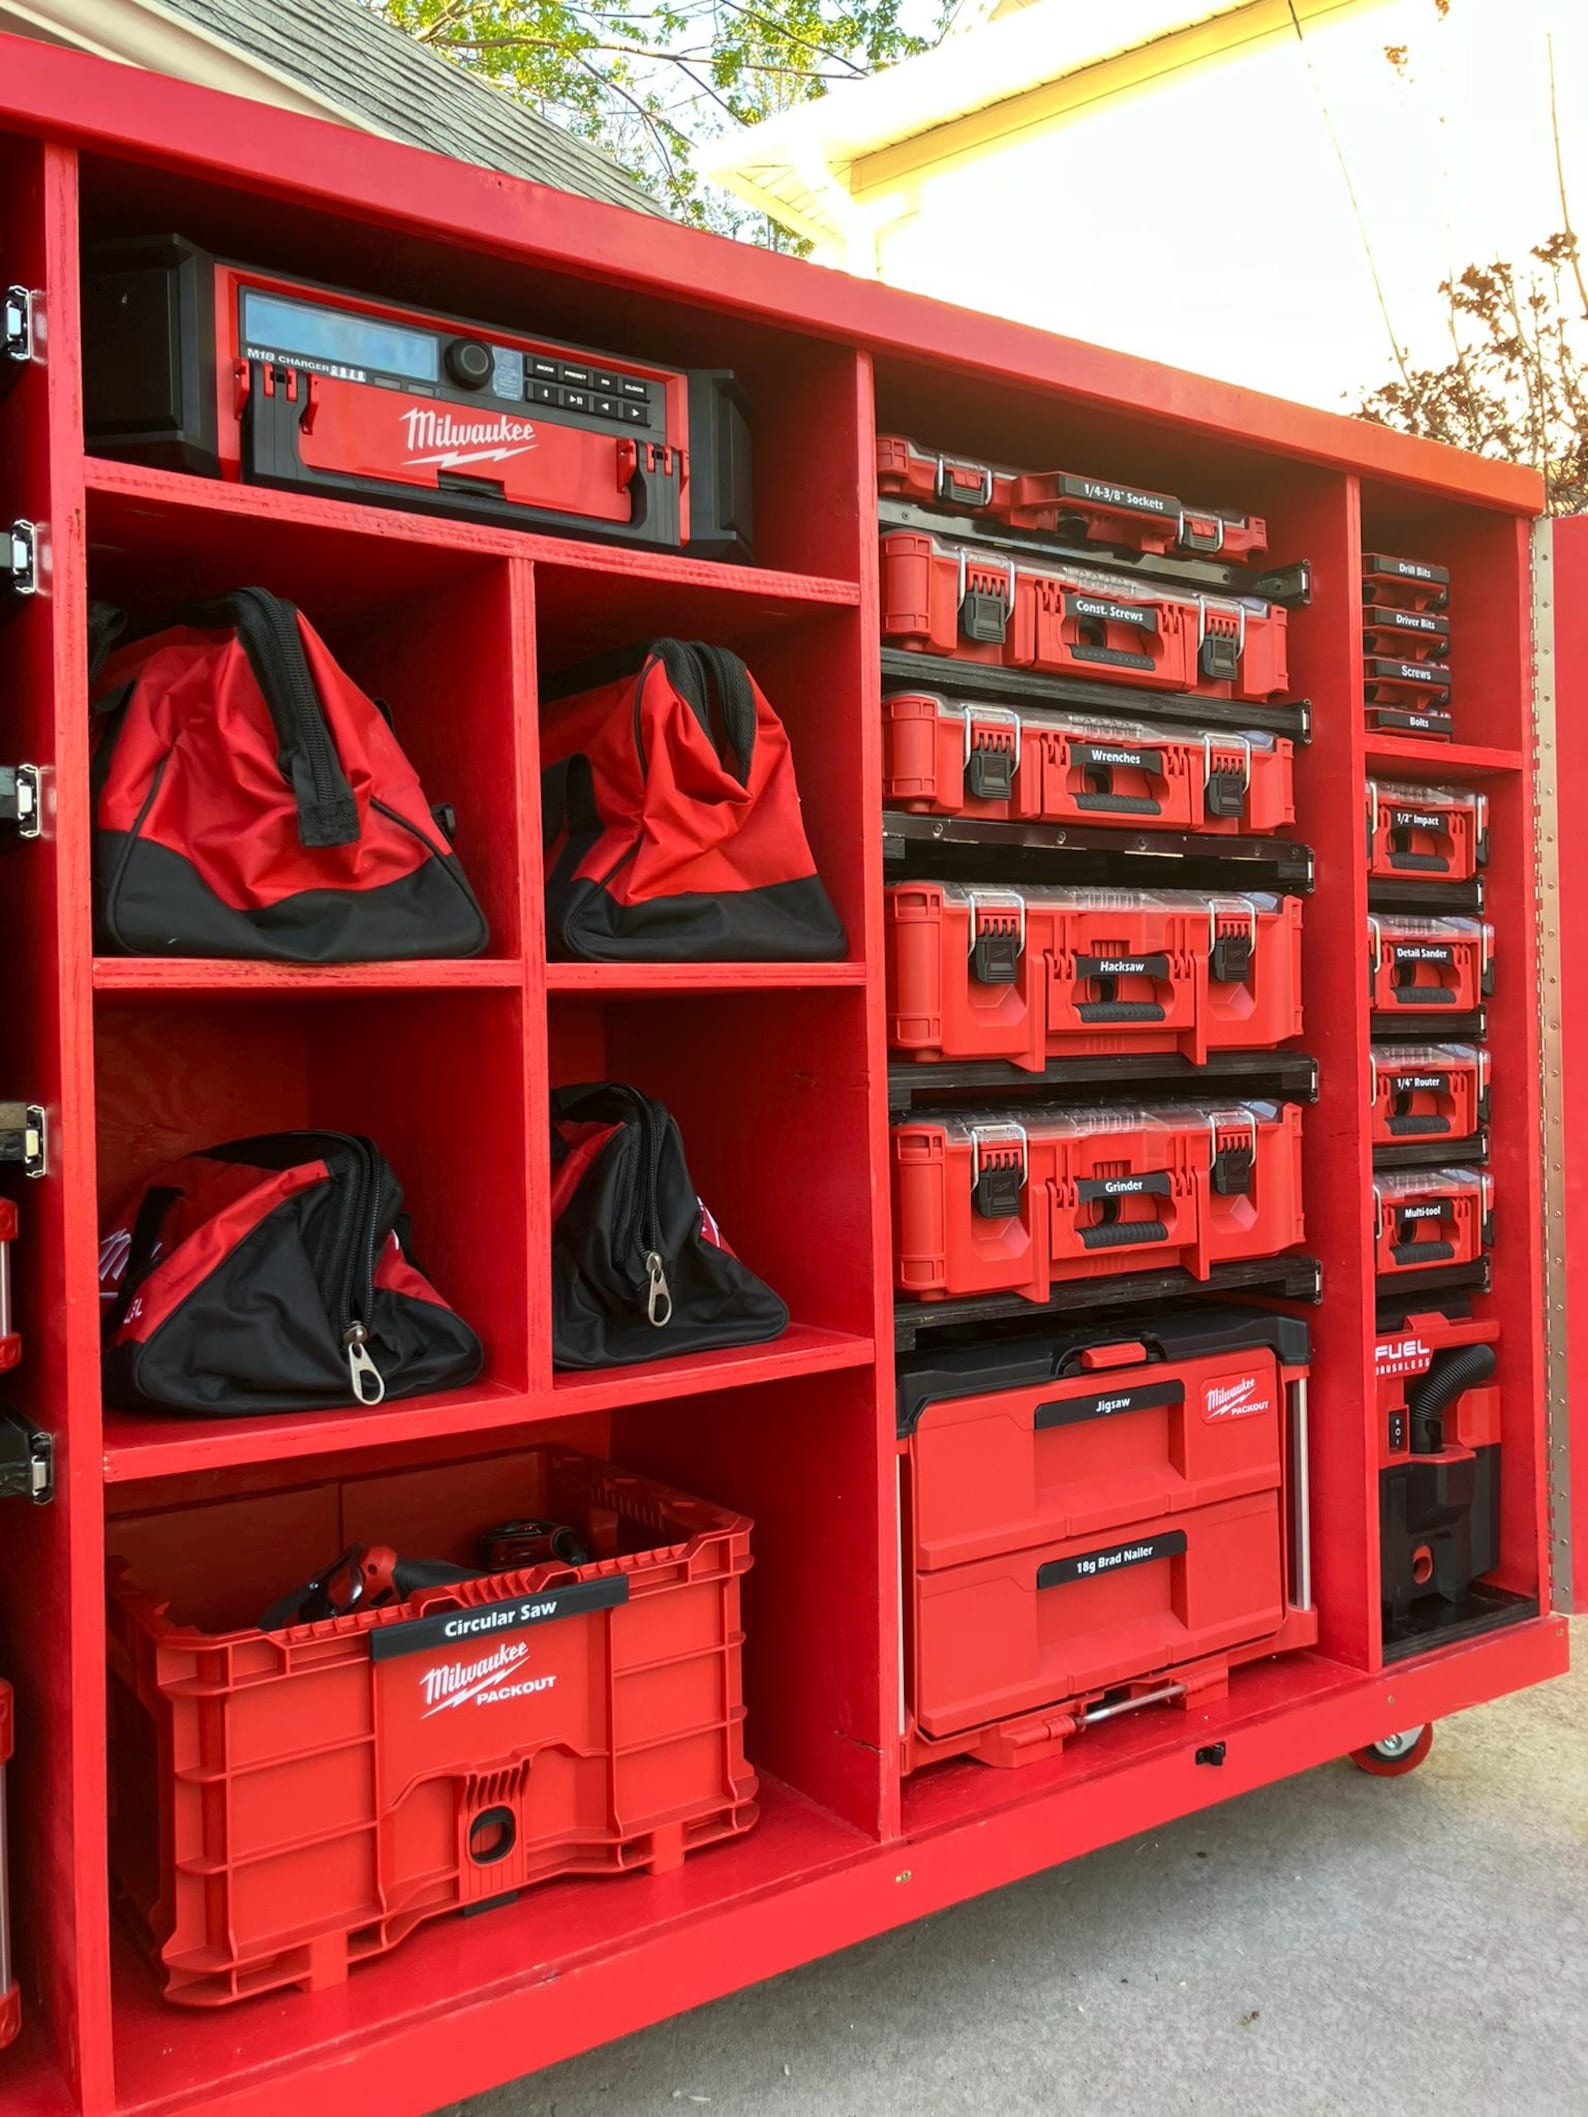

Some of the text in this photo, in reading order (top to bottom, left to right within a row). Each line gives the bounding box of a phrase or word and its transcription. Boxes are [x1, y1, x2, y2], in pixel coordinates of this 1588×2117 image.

[247, 347, 330, 373] M18 CHARGER
[399, 407, 537, 451] Milwaukee
[1127, 493, 1164, 510] Sockets
[1399, 563, 1431, 578] Drill Bits
[1076, 600, 1144, 621] Const. Screws
[1396, 614, 1435, 630] Driver Bits
[1401, 665, 1431, 680] Screws
[1409, 716, 1429, 728] Bolts
[1091, 749, 1141, 764] Wrenches
[1413, 814, 1439, 827] Impact
[1397, 948, 1447, 958] Detail Sander
[1100, 961, 1144, 972] Hacksaw
[1414, 1077, 1440, 1087] Router
[1105, 1180, 1143, 1193] Grinder
[1404, 1204, 1441, 1219] Multi-tool
[1375, 1339, 1430, 1362] FUEL
[1205, 1377, 1256, 1411] Milwaukee
[1095, 1398, 1131, 1413] Jigsaw
[1231, 1400, 1269, 1416] PACKOUT
[1077, 1546, 1154, 1574] 18g Brad Nailer
[445, 1601, 557, 1637] Circular Saw
[420, 1641, 529, 1705] Milwaukee
[476, 1675, 557, 1705] PACKOUT
